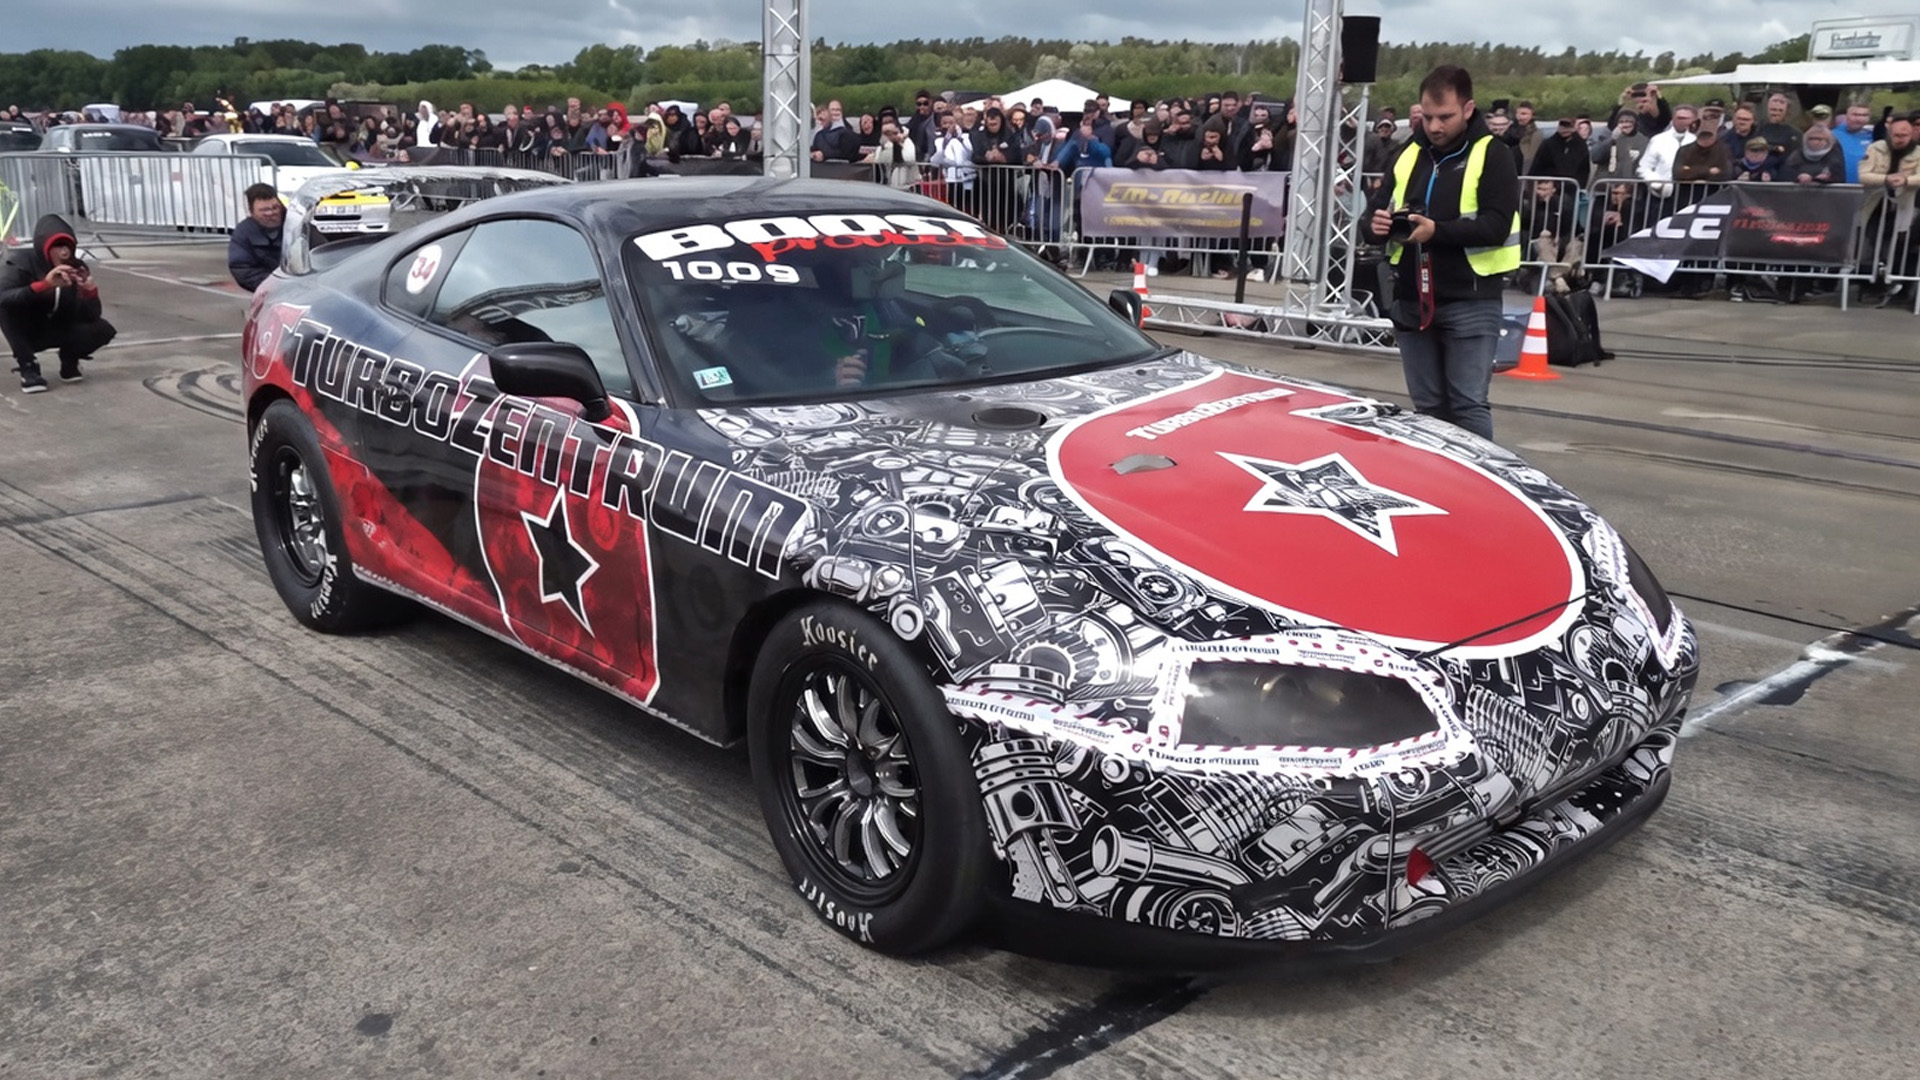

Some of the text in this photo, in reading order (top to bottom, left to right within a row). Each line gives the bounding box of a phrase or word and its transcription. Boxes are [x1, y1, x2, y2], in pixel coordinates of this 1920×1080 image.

[633, 214, 1004, 261] BOOST
[411, 256, 436, 281] 34
[293, 317, 811, 580] TURBOZENTRUM
